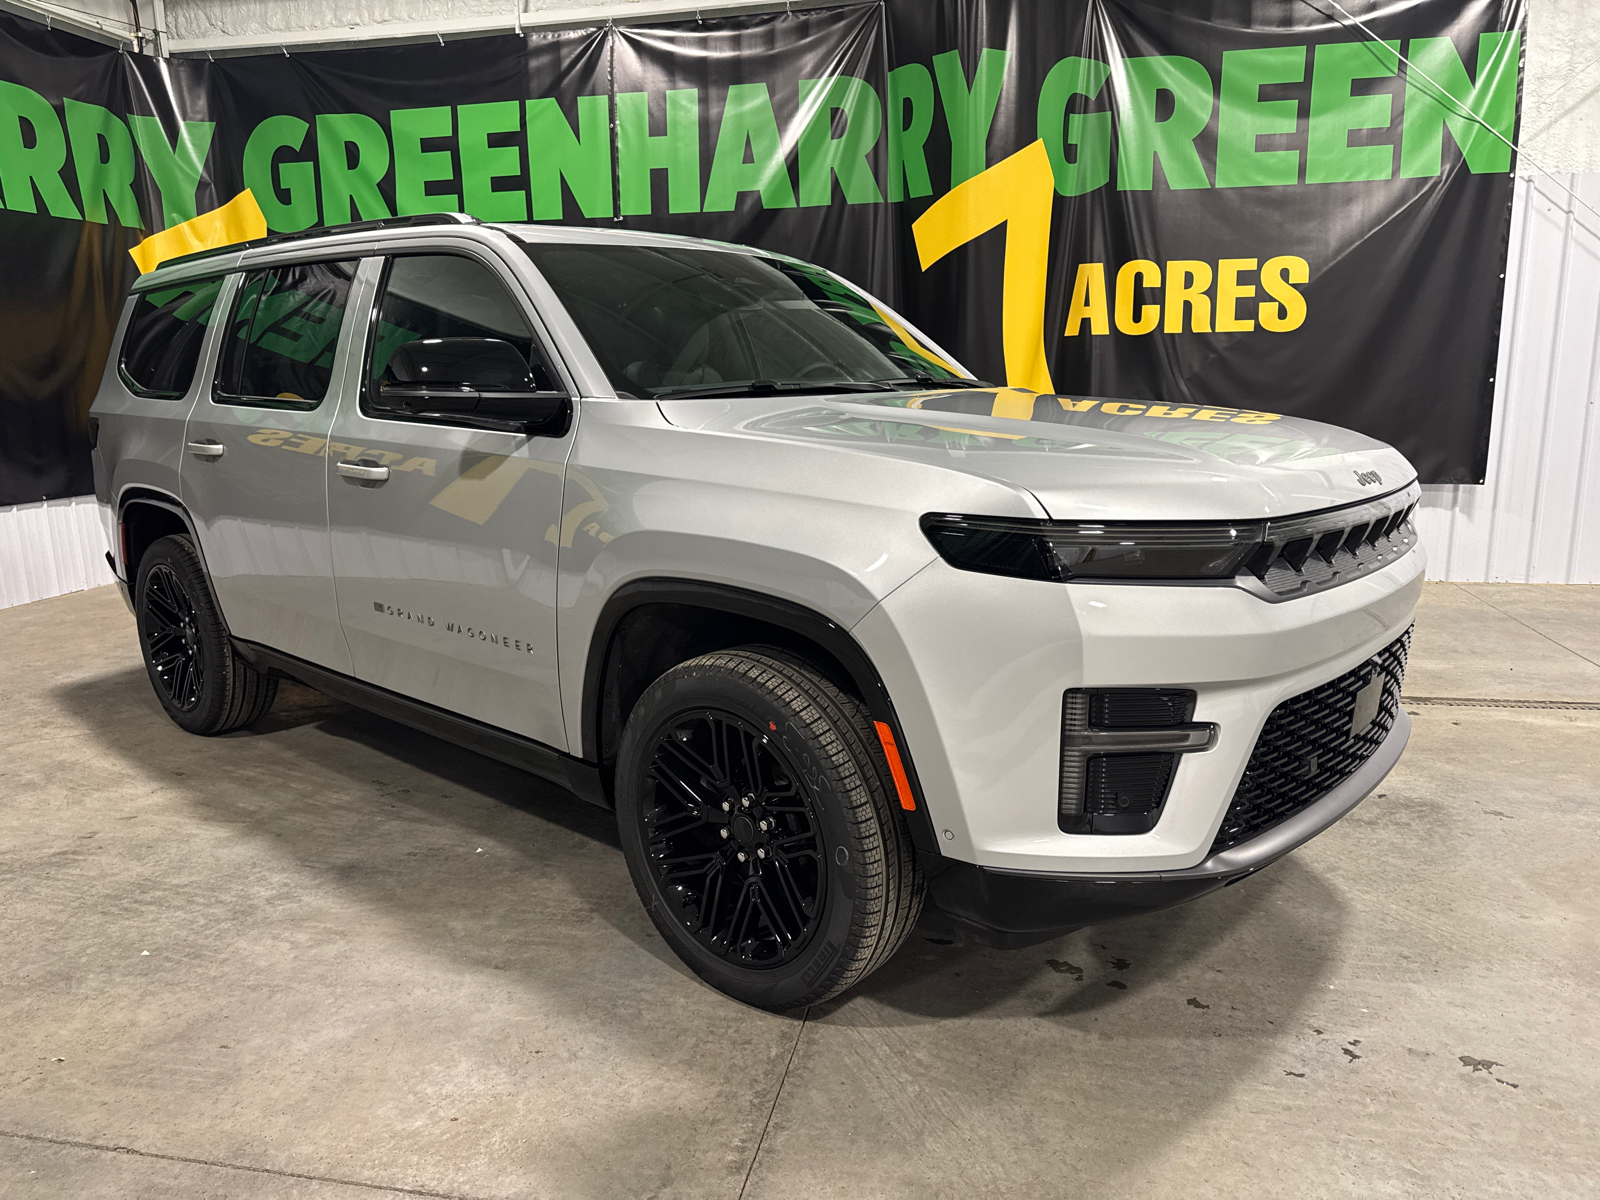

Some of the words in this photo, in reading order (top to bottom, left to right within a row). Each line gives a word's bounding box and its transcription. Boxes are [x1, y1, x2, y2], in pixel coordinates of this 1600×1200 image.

[0, 80, 216, 231] RRY
[243, 96, 614, 233] GREEN
[617, 47, 1012, 215] HARRY
[1037, 31, 1520, 197] GREEN
[911, 138, 1056, 395] 7
[1064, 255, 1310, 337] ACRES
[1353, 469, 1383, 487] Jeep
[387, 605, 435, 627] GRAND
[445, 621, 534, 655] WAGONEER
